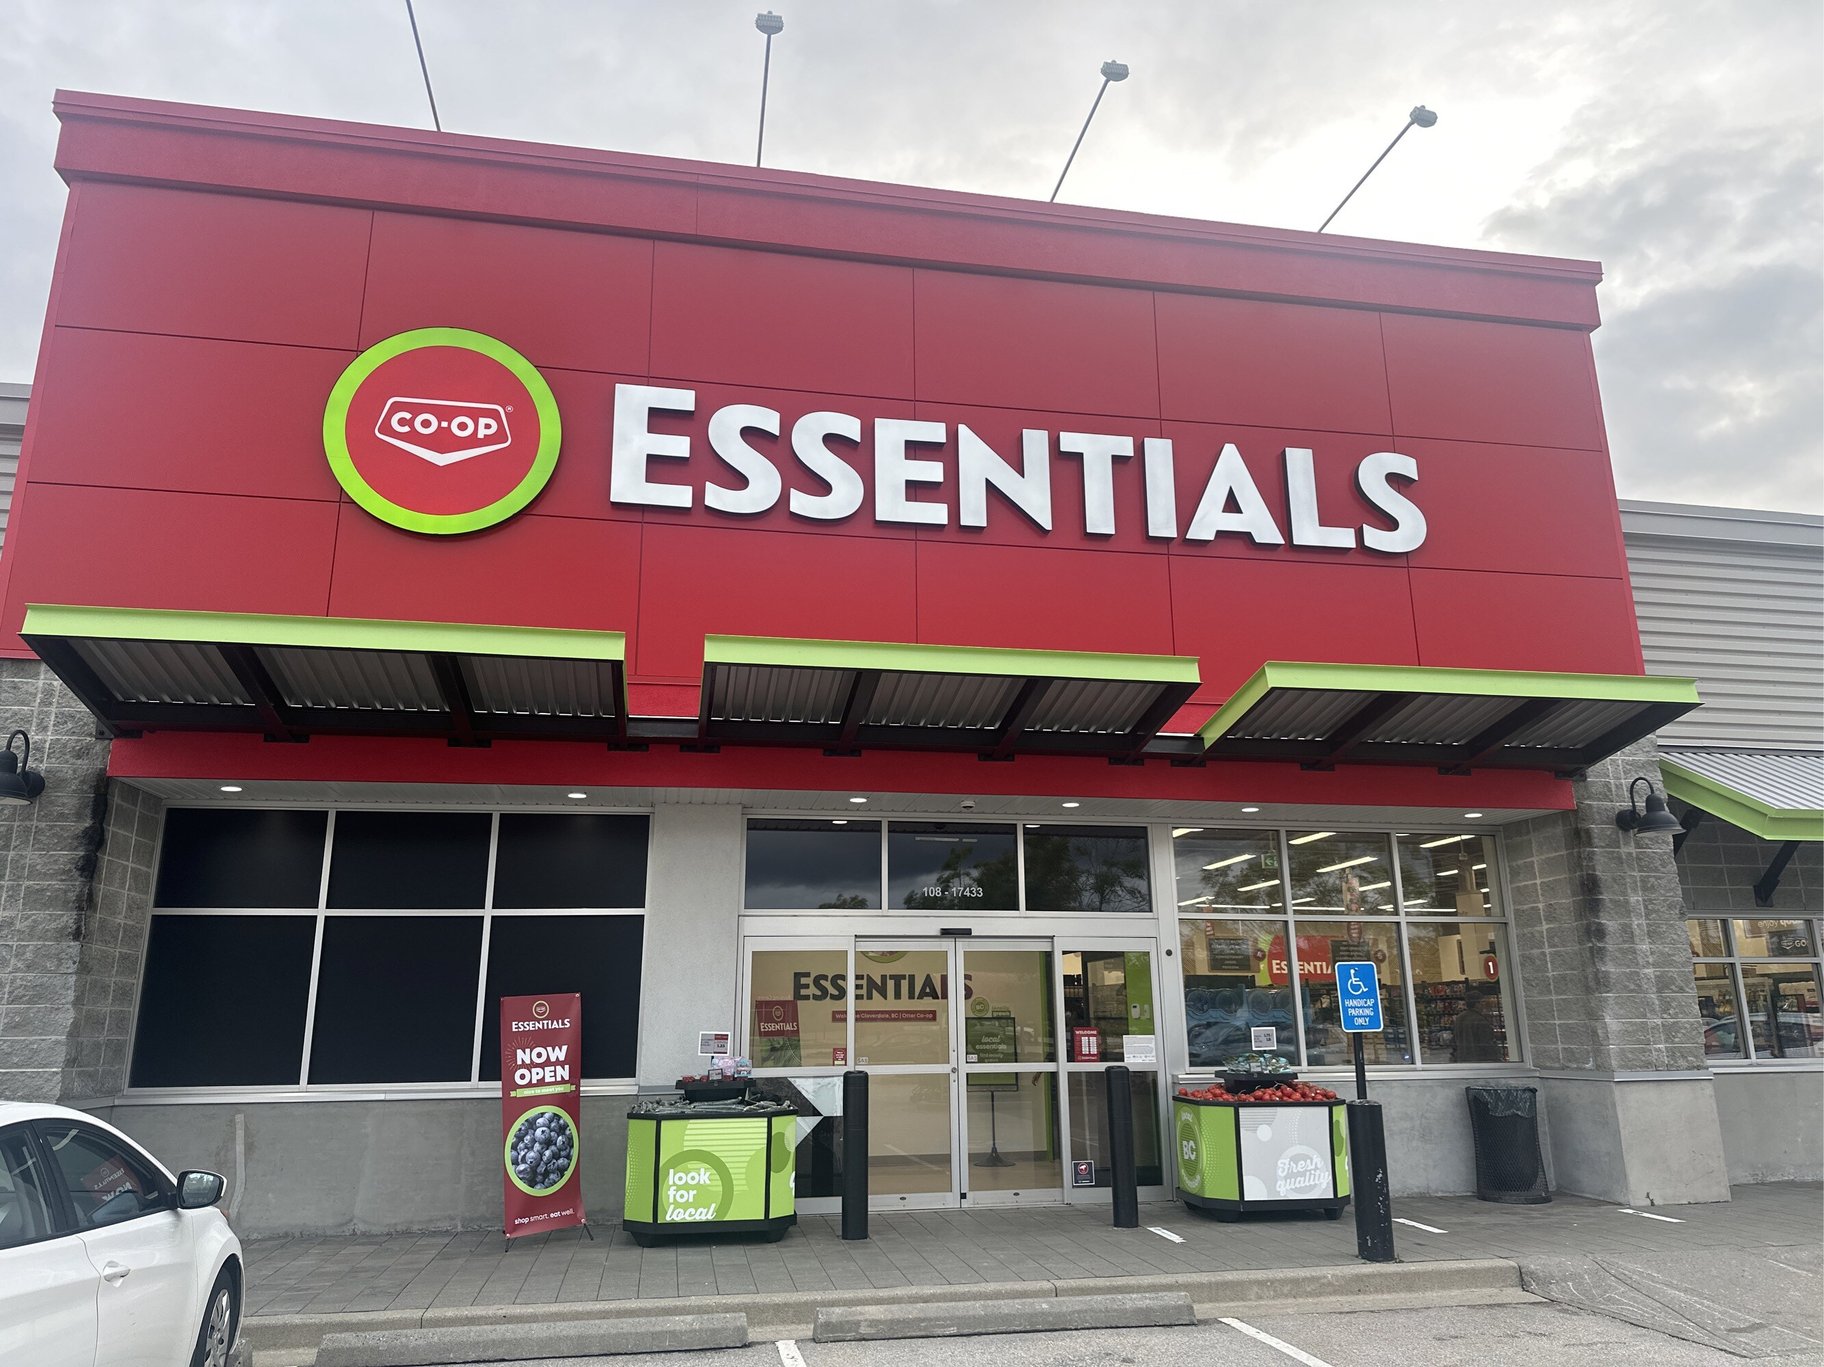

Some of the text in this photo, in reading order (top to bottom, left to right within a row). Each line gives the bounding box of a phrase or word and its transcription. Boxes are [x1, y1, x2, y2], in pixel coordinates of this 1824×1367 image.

[390, 410, 498, 439] CO-OP
[610, 383, 1428, 553] ESSENTIALS
[922, 886, 941, 898] 108
[951, 886, 984, 898] 17433
[1272, 959, 1332, 974] ESENTI
[1488, 961, 1494, 974] 1
[1344, 998, 1375, 1007] HANDICAP
[1348, 1008, 1374, 1016] PARKING
[512, 1019, 571, 1032] ESSENTIALS
[760, 1022, 797, 1031] ESSENTIALS
[1354, 1017, 1369, 1025] ONLY
[516, 1045, 568, 1065] NOW
[514, 1065, 570, 1085] OPEN
[1182, 1140, 1196, 1160] BC
[1277, 1154, 1324, 1177] Fresh
[668, 1167, 711, 1185] look
[1276, 1168, 1333, 1196] quality
[667, 1186, 697, 1203] for
[665, 1203, 716, 1221] local
[514, 1217, 529, 1225] shop
